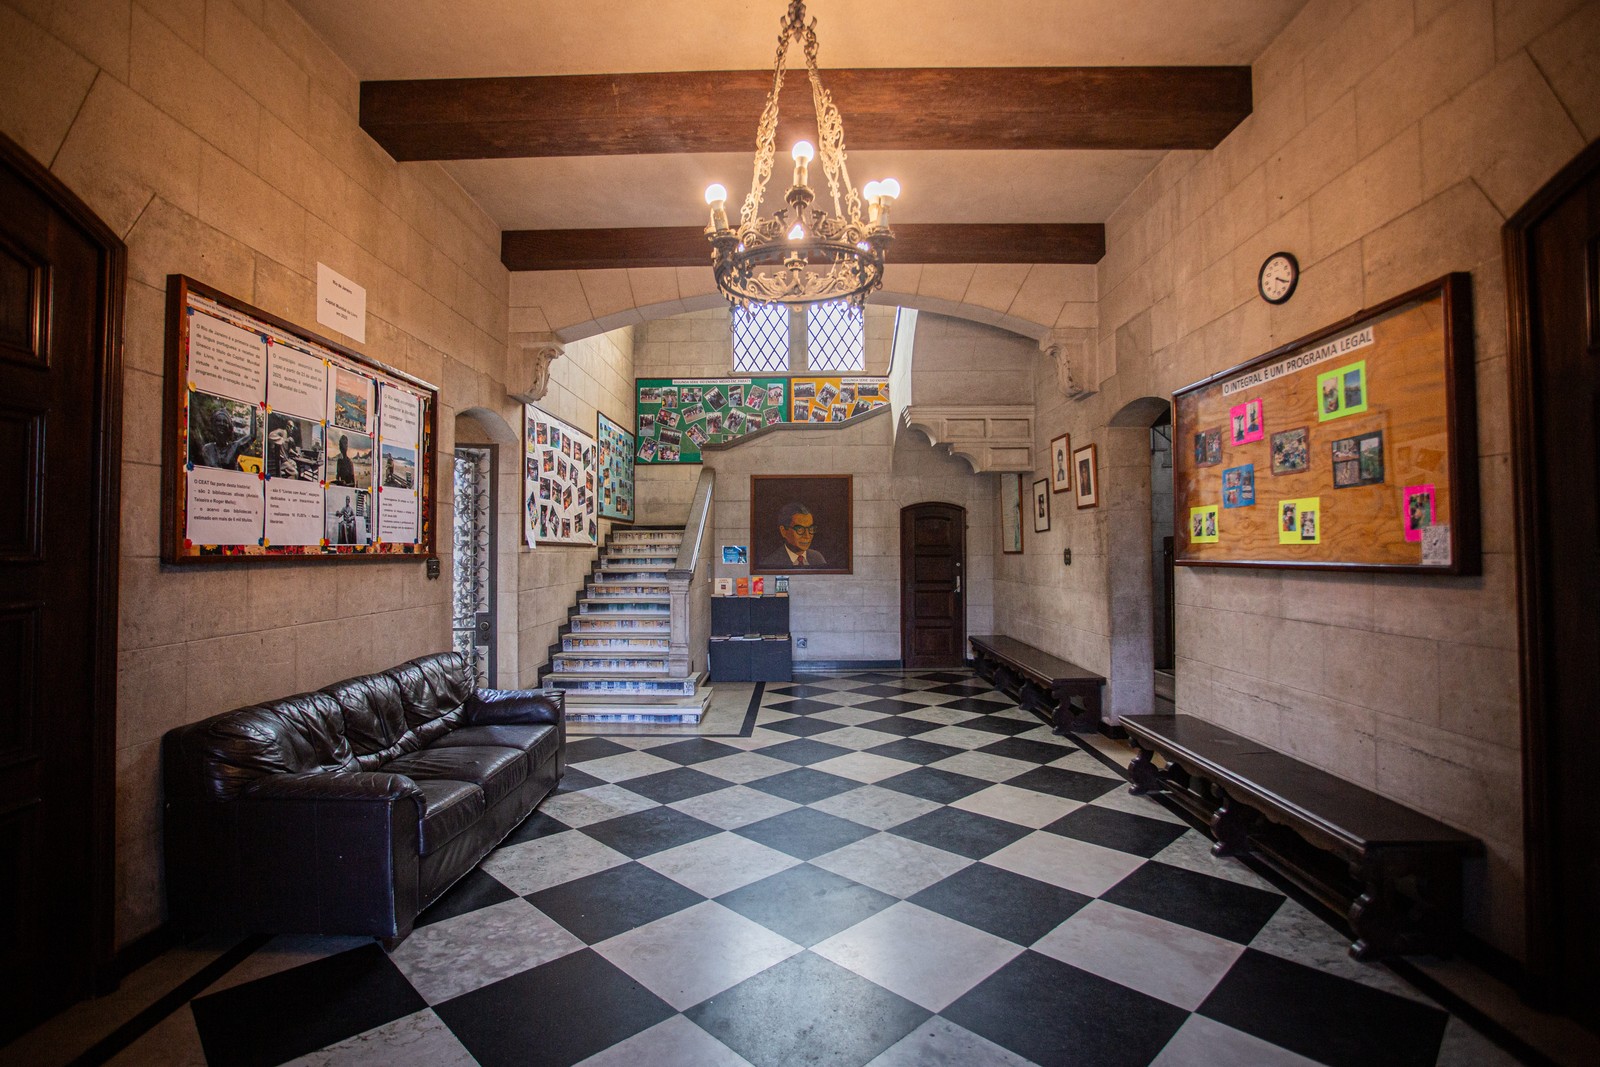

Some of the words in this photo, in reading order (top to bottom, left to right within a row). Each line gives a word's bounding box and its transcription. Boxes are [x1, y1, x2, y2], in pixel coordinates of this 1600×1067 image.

[1224, 384, 1229, 394] O
[1230, 373, 1262, 391] INTEGRAL
[1264, 367, 1269, 378] É
[1270, 364, 1284, 378] UM
[1287, 344, 1338, 373] PROGRAMA
[1340, 330, 1371, 351] LEGAL
